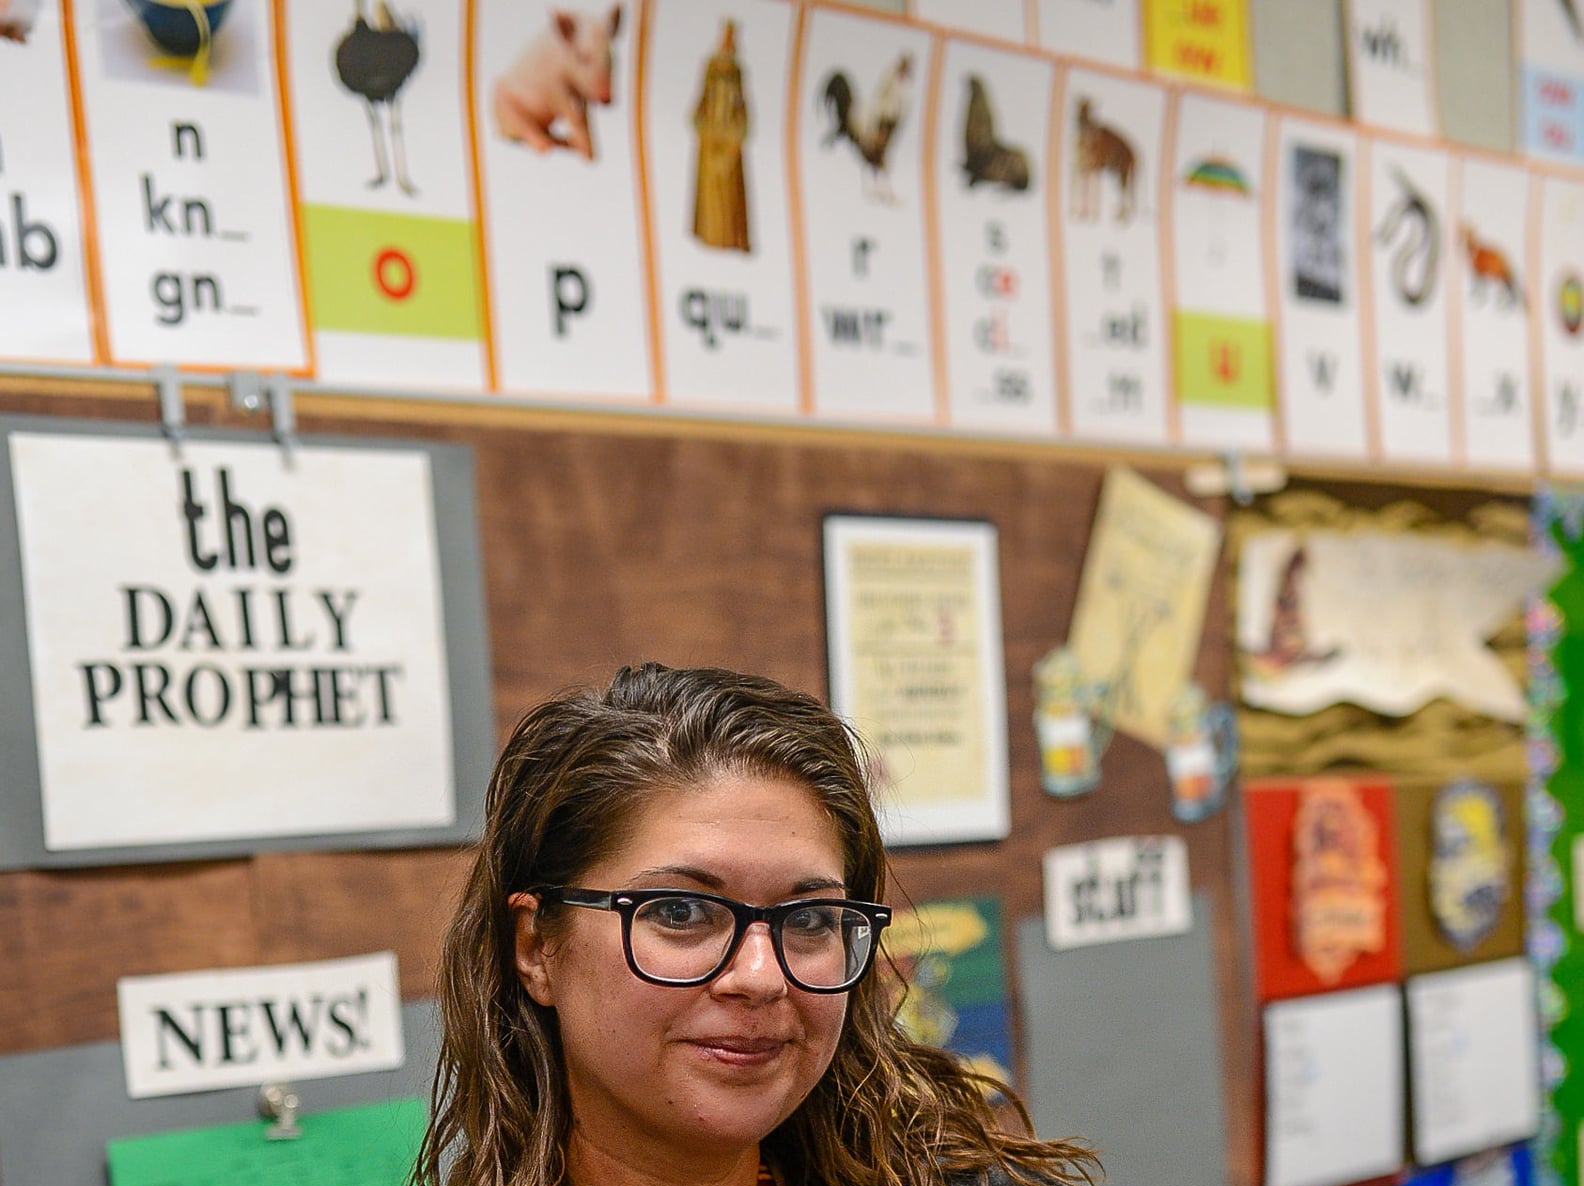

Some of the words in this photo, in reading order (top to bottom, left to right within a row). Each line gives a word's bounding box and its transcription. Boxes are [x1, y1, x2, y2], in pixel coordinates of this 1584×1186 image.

[172, 120, 205, 160] n
[0, 192, 59, 272] b
[550, 264, 591, 336] p
[181, 467, 296, 574] the
[121, 585, 358, 653] DAILY
[78, 662, 401, 730] PROPHET
[151, 987, 372, 1069] NEWS!
